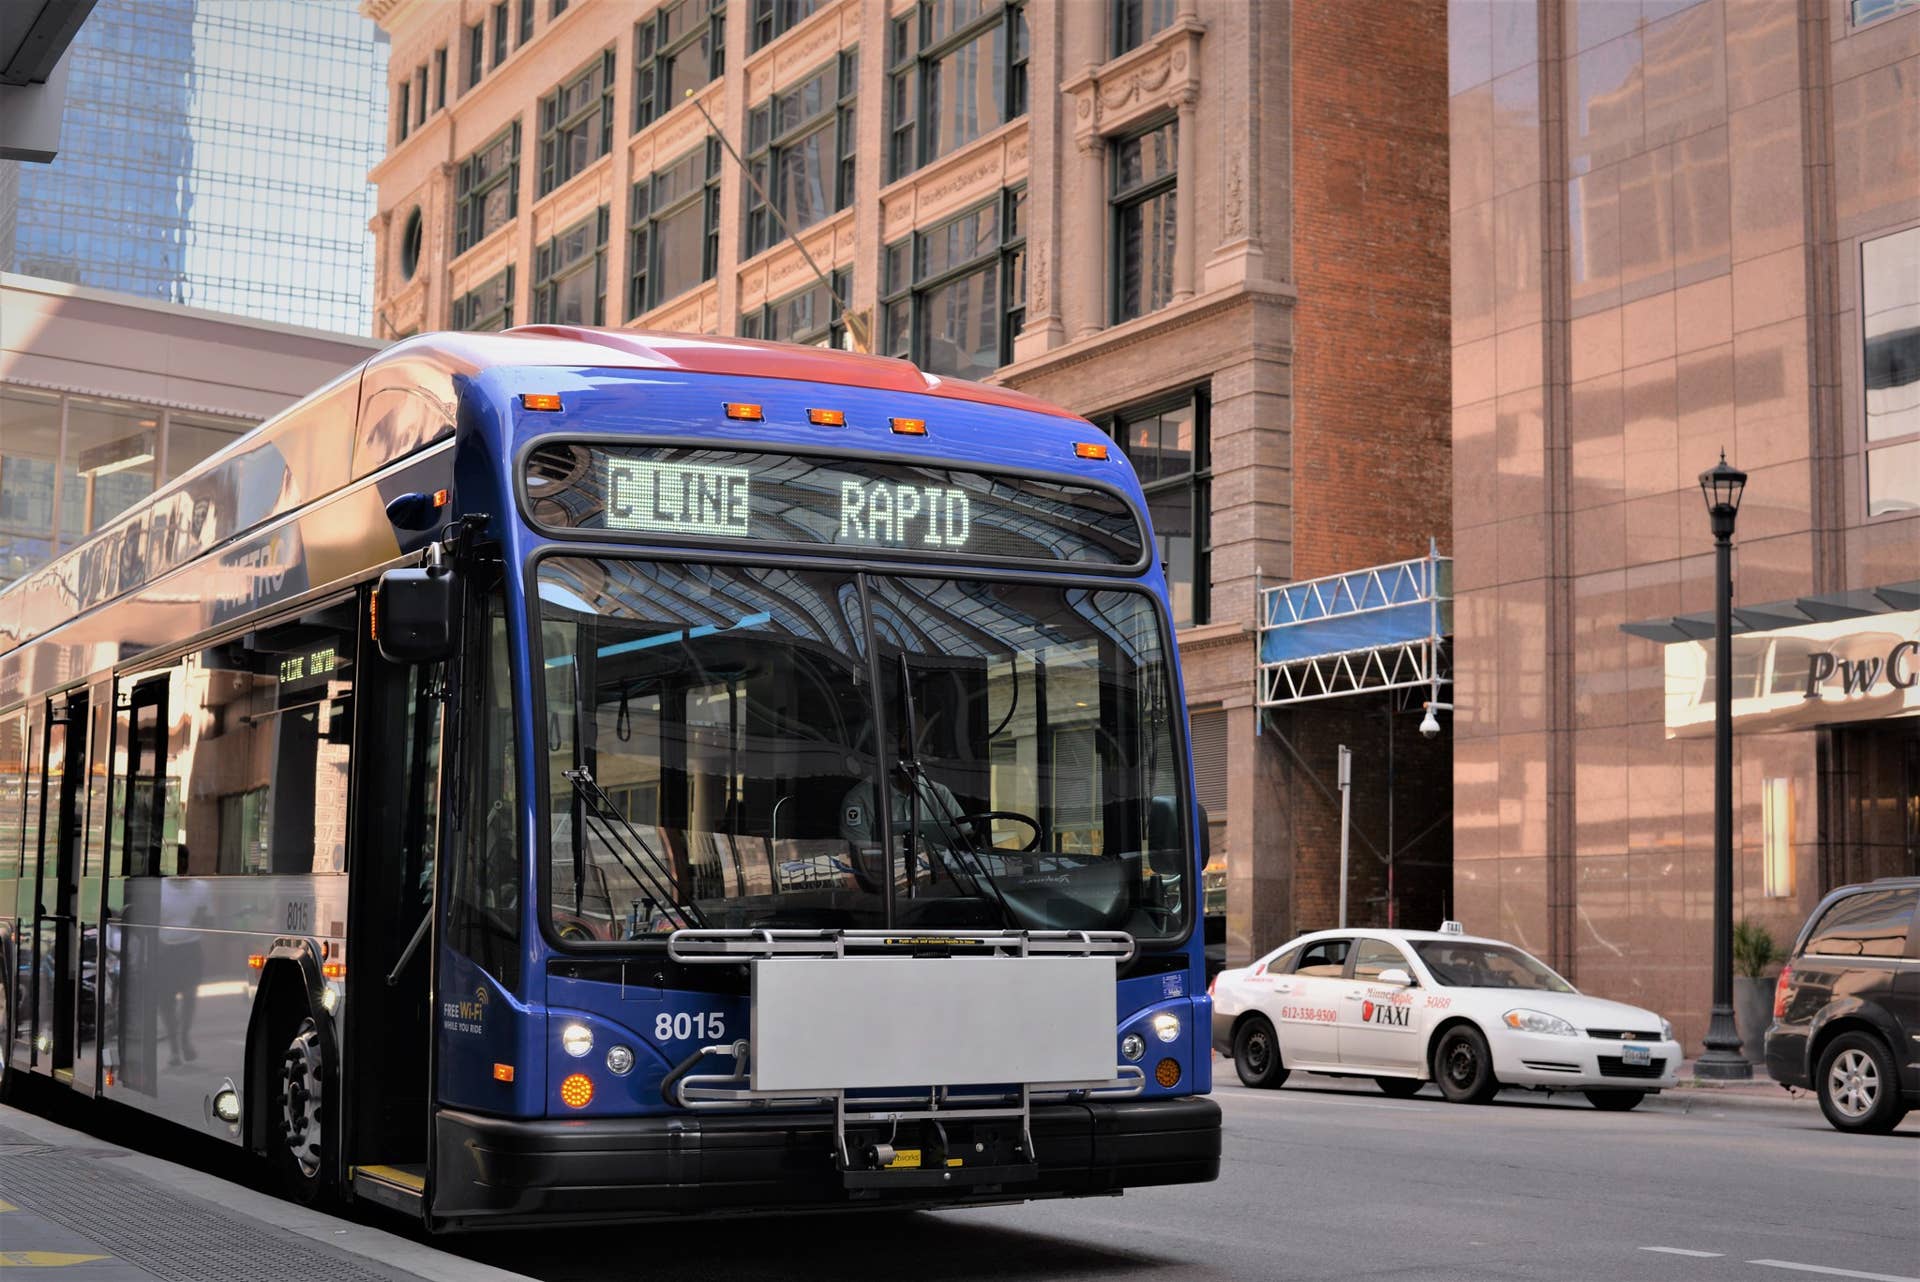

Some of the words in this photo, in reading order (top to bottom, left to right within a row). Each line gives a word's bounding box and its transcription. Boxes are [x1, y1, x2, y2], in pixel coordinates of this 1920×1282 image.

[611, 466, 633, 519] C
[653, 471, 748, 527] LINE
[841, 480, 970, 546] RAPID
[1803, 641, 1920, 698] PwC
[287, 901, 308, 931] 8015
[443, 1003, 459, 1018] FREE
[460, 1000, 482, 1021] Wi-Fi
[1375, 1004, 1410, 1026] TAXI
[444, 1020, 458, 1031] WHILE
[459, 1022, 469, 1033] YOU
[470, 1024, 482, 1034] RIDE
[655, 1012, 725, 1040] 8015
